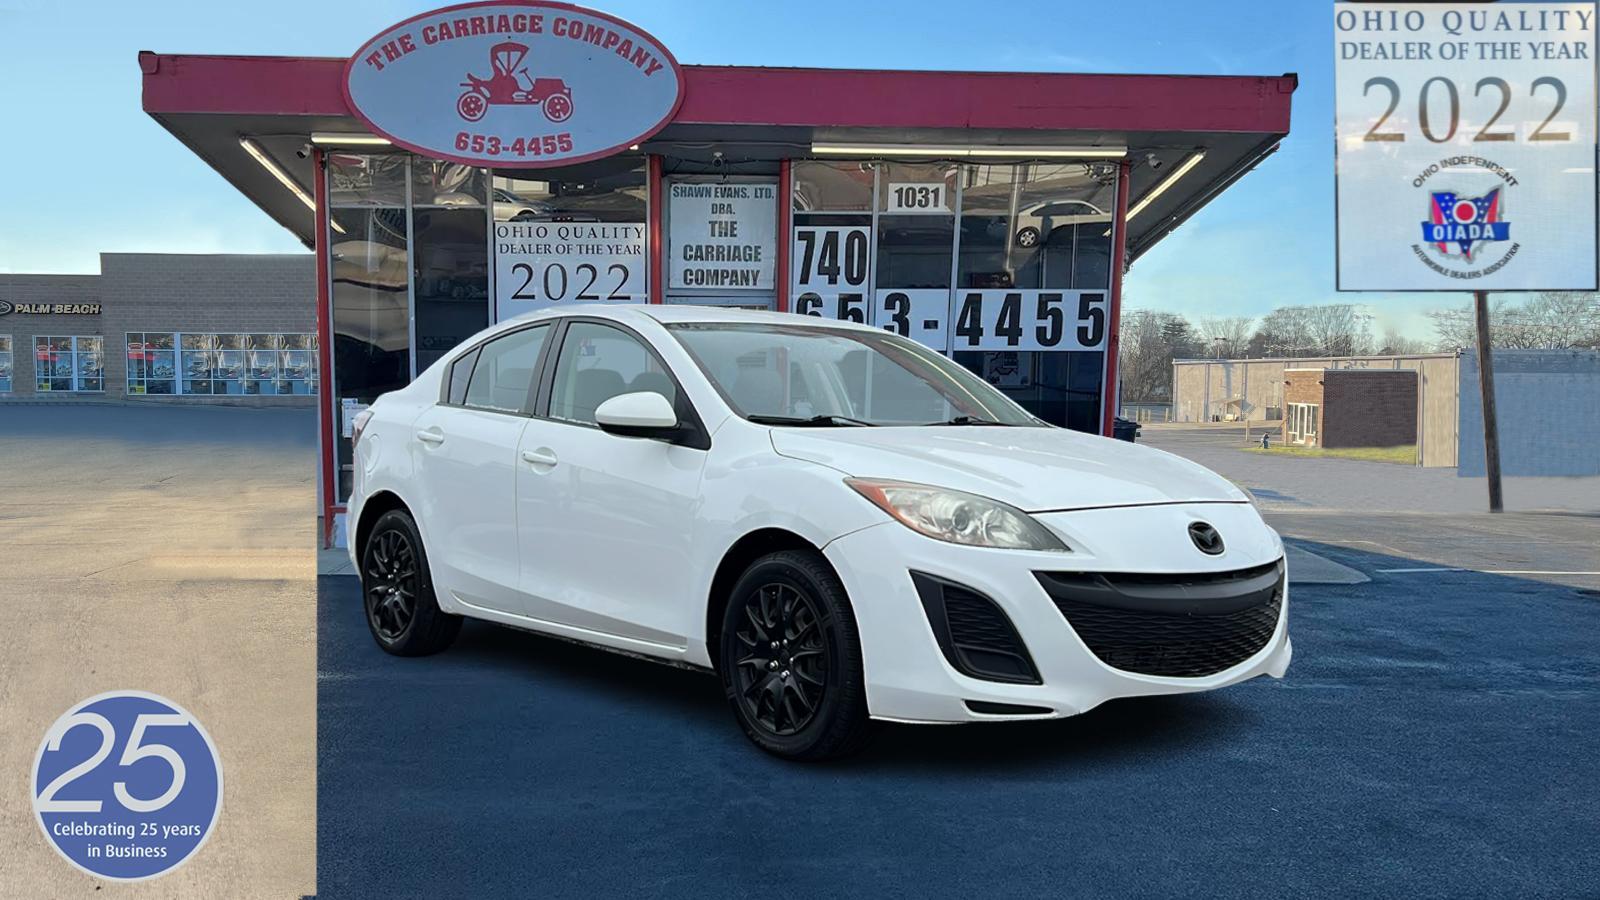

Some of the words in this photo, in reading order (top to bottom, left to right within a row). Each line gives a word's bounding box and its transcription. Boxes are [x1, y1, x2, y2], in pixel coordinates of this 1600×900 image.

[1336, 10, 1425, 31] OHIO
[1442, 10, 1593, 36] QUALITY
[366, 33, 416, 72] THE
[422, 14, 544, 45] CARRIAGE
[553, 17, 664, 77] COMPANY
[1340, 41, 1433, 60] DEALER
[1439, 41, 1469, 60] OF
[1475, 41, 1522, 60] THE
[1528, 41, 1589, 60] YEAR
[1363, 76, 1571, 143] 2022
[454, 131, 573, 157] 653-4455
[1412, 163, 1440, 188] OHIO
[1440, 156, 1519, 187] INDEPENDENT
[672, 185, 714, 199] SHAWN
[754, 186, 775, 200] LTD.
[894, 186, 941, 208] 1031
[711, 203, 736, 215] DBA.
[496, 226, 548, 239] OHIO
[558, 226, 644, 241] QUALITY
[708, 220, 738, 238] THE
[1432, 224, 1495, 241] OIADA
[499, 243, 552, 255] DEALER
[555, 243, 573, 255] OF
[576, 243, 603, 255] THE
[606, 243, 642, 255] YEAR
[683, 244, 762, 262] CARRIAGE
[797, 230, 868, 286] 740
[511, 263, 632, 301] 2022
[683, 269, 761, 286] COMPANY
[14, 304, 51, 314] PALM
[54, 304, 100, 314] BEACH
